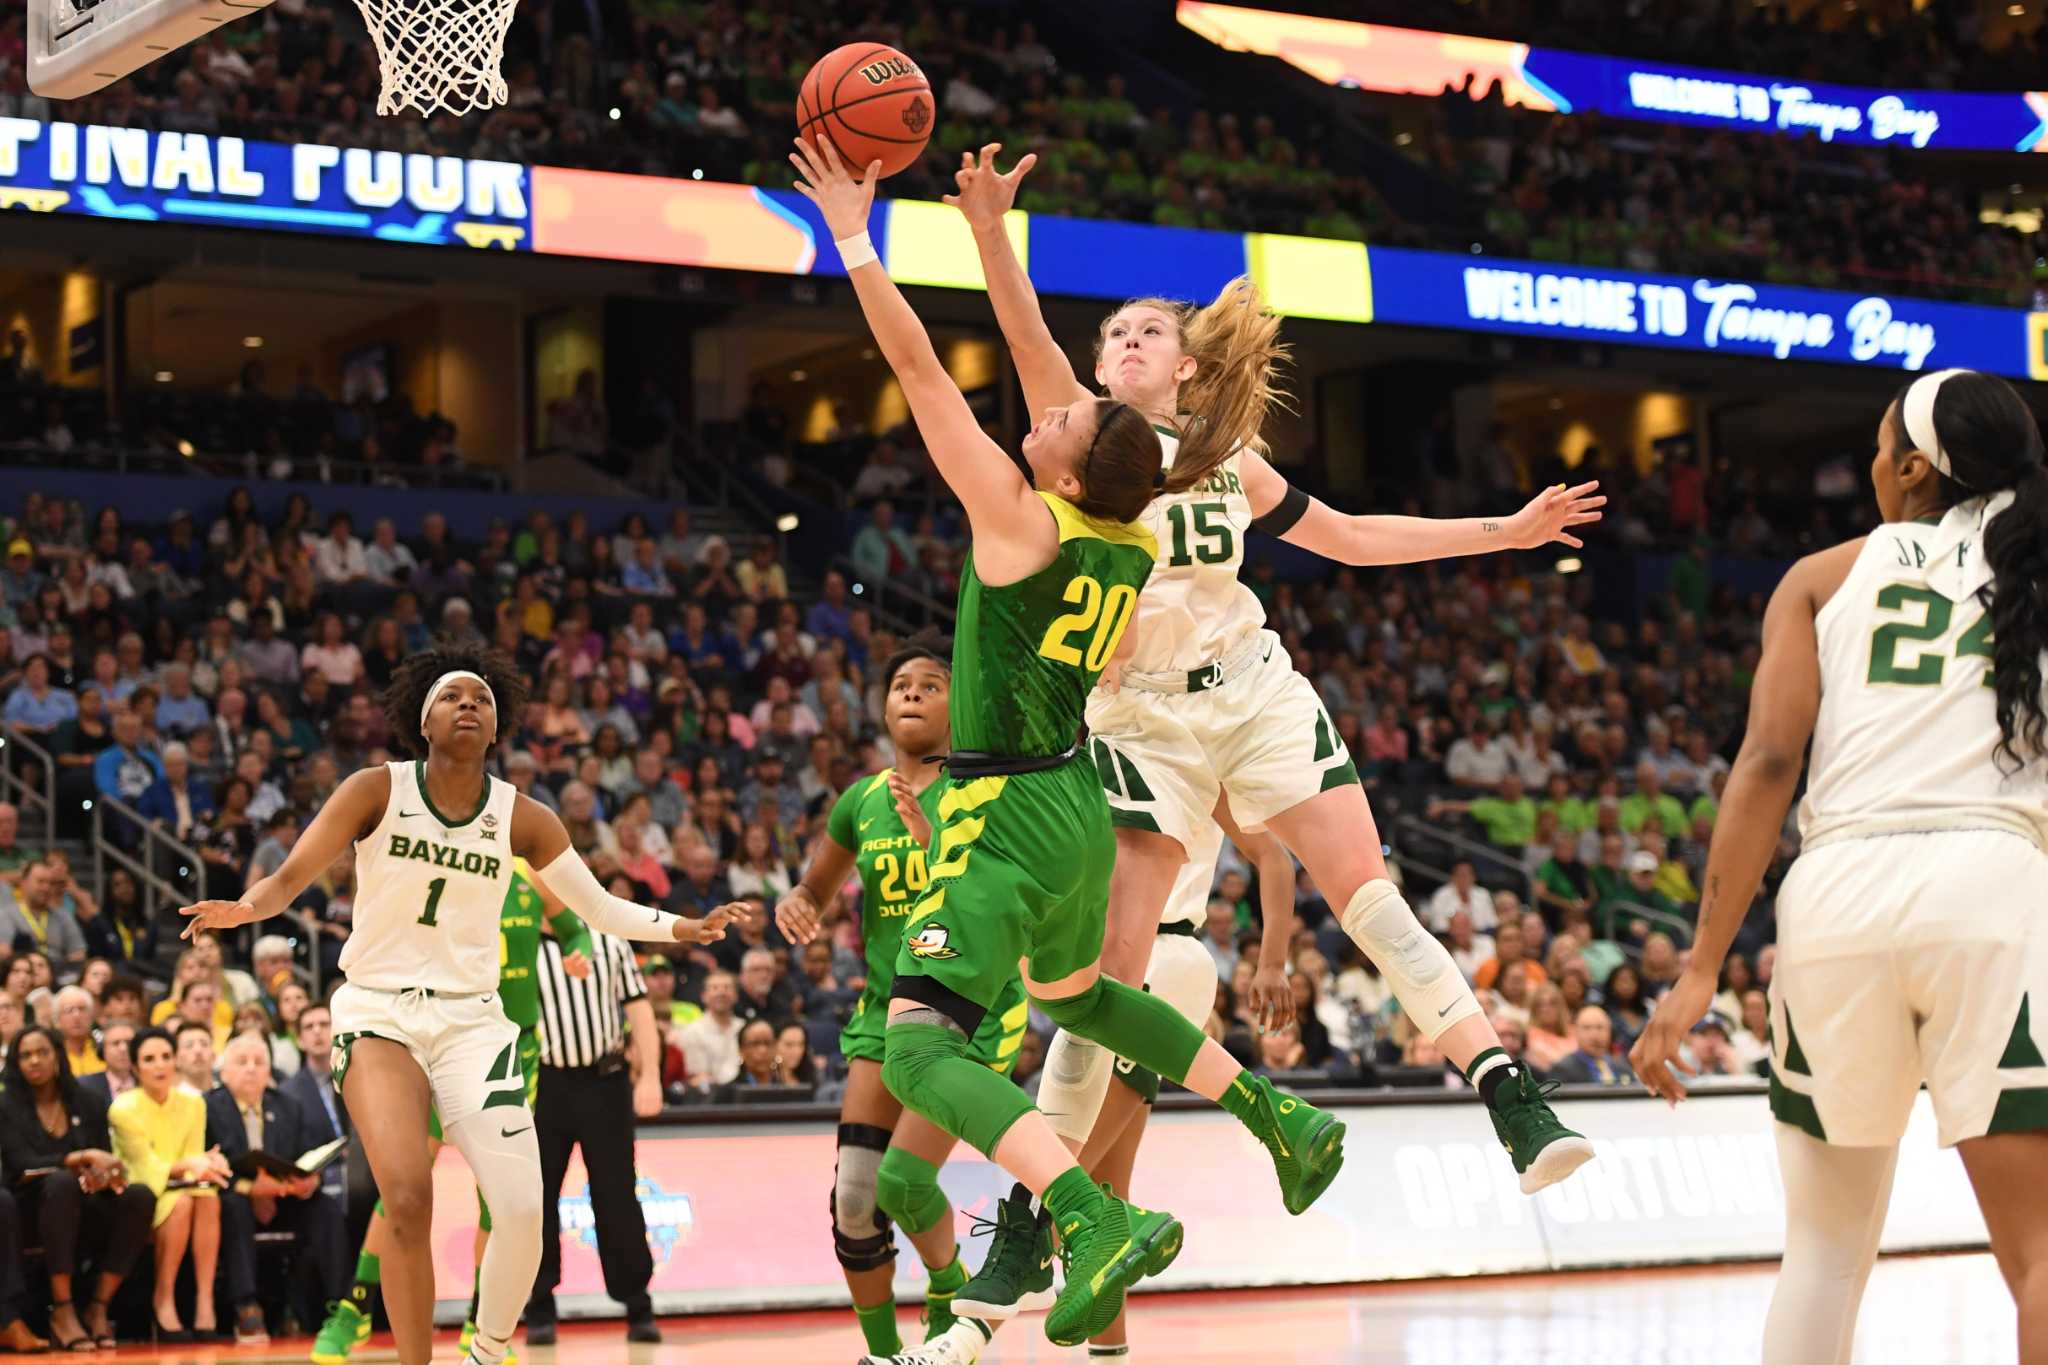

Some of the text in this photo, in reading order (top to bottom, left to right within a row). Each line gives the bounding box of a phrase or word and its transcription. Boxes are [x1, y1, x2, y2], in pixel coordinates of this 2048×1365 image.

[1770, 83, 1862, 142] Tampa
[1867, 95, 1940, 149] Bay
[1463, 267, 1936, 371] WELCOME TO Tampa Bay
[1167, 502, 1234, 567] 15
[1039, 575, 1138, 672] 20
[388, 834, 501, 880] BAYLOR
[874, 850, 928, 901] 24
[416, 877, 447, 927] 1
